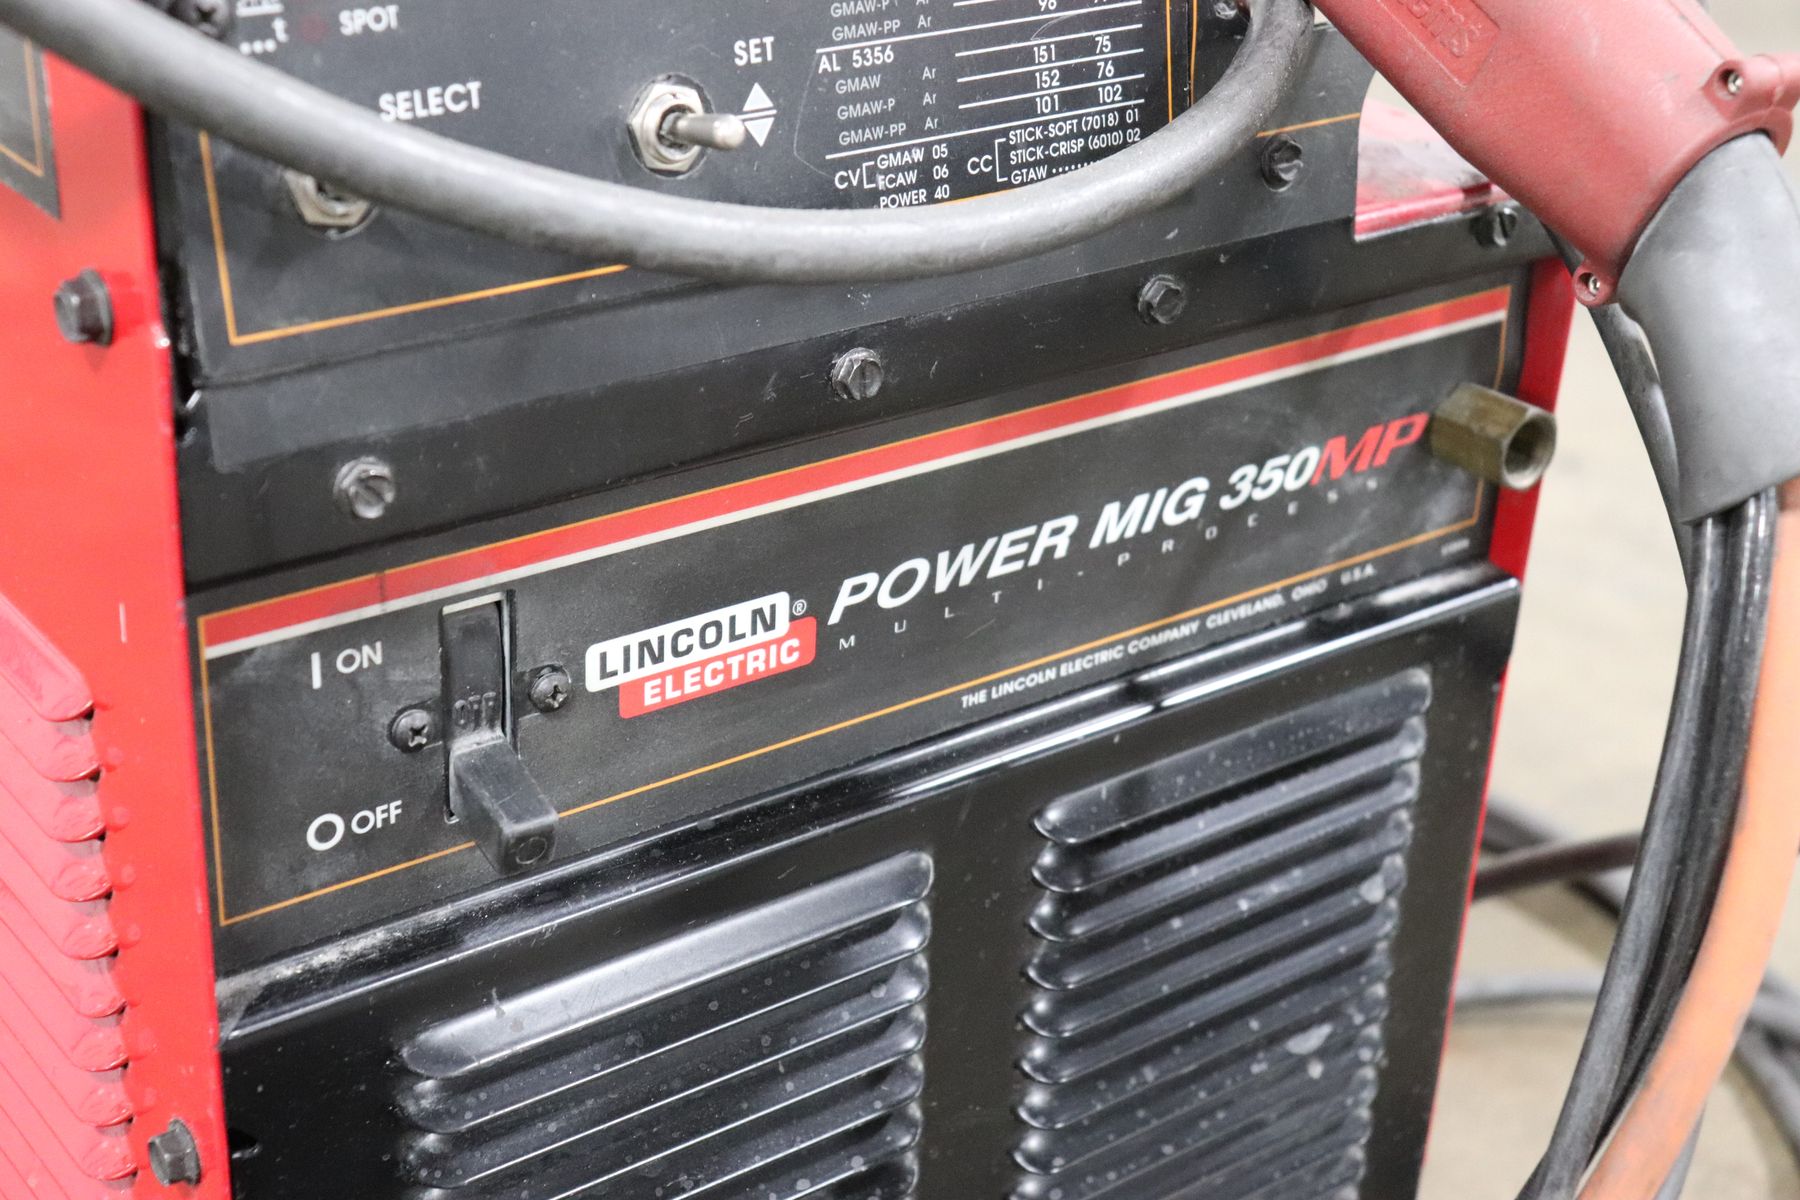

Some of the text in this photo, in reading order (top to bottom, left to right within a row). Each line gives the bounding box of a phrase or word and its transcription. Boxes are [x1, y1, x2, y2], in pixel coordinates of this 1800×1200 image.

[338, 4, 399, 36] SPOT
[832, 19, 901, 41] GMAW-PP
[917, 14, 932, 29] Ar
[733, 36, 775, 67] SET
[818, 45, 895, 74] AL 5356
[835, 35, 1112, 95] GMAW Ar 151 75
[378, 80, 482, 123] SELECT
[837, 60, 1115, 120] GMAW-P Ar 152 76
[838, 84, 1122, 146] GMAW-PP Ar 101 102
[1008, 108, 1139, 145] STICK-SOFT (7018) 01
[877, 143, 949, 170] GMAW 05
[1009, 128, 1141, 165] STICK-CRISP (6010) 02
[834, 169, 860, 190] CV
[878, 164, 949, 191] FCAW 06
[967, 154, 993, 175] CC
[1010, 164, 1048, 185] GTAW
[879, 184, 950, 210] POWER 40
[827, 514, 1079, 626] POWER
[1088, 477, 1211, 549] MIG
[335, 640, 383, 674] ON
[599, 602, 778, 682] LINCOLN
[643, 637, 801, 707] ELECTRIC
[961, 690, 987, 710] THE
[991, 668, 1057, 701] LINCOLN
[1059, 645, 1124, 679] ELECTRIC
[1127, 623, 1201, 655] COMPANY
[350, 799, 402, 835] OFF
